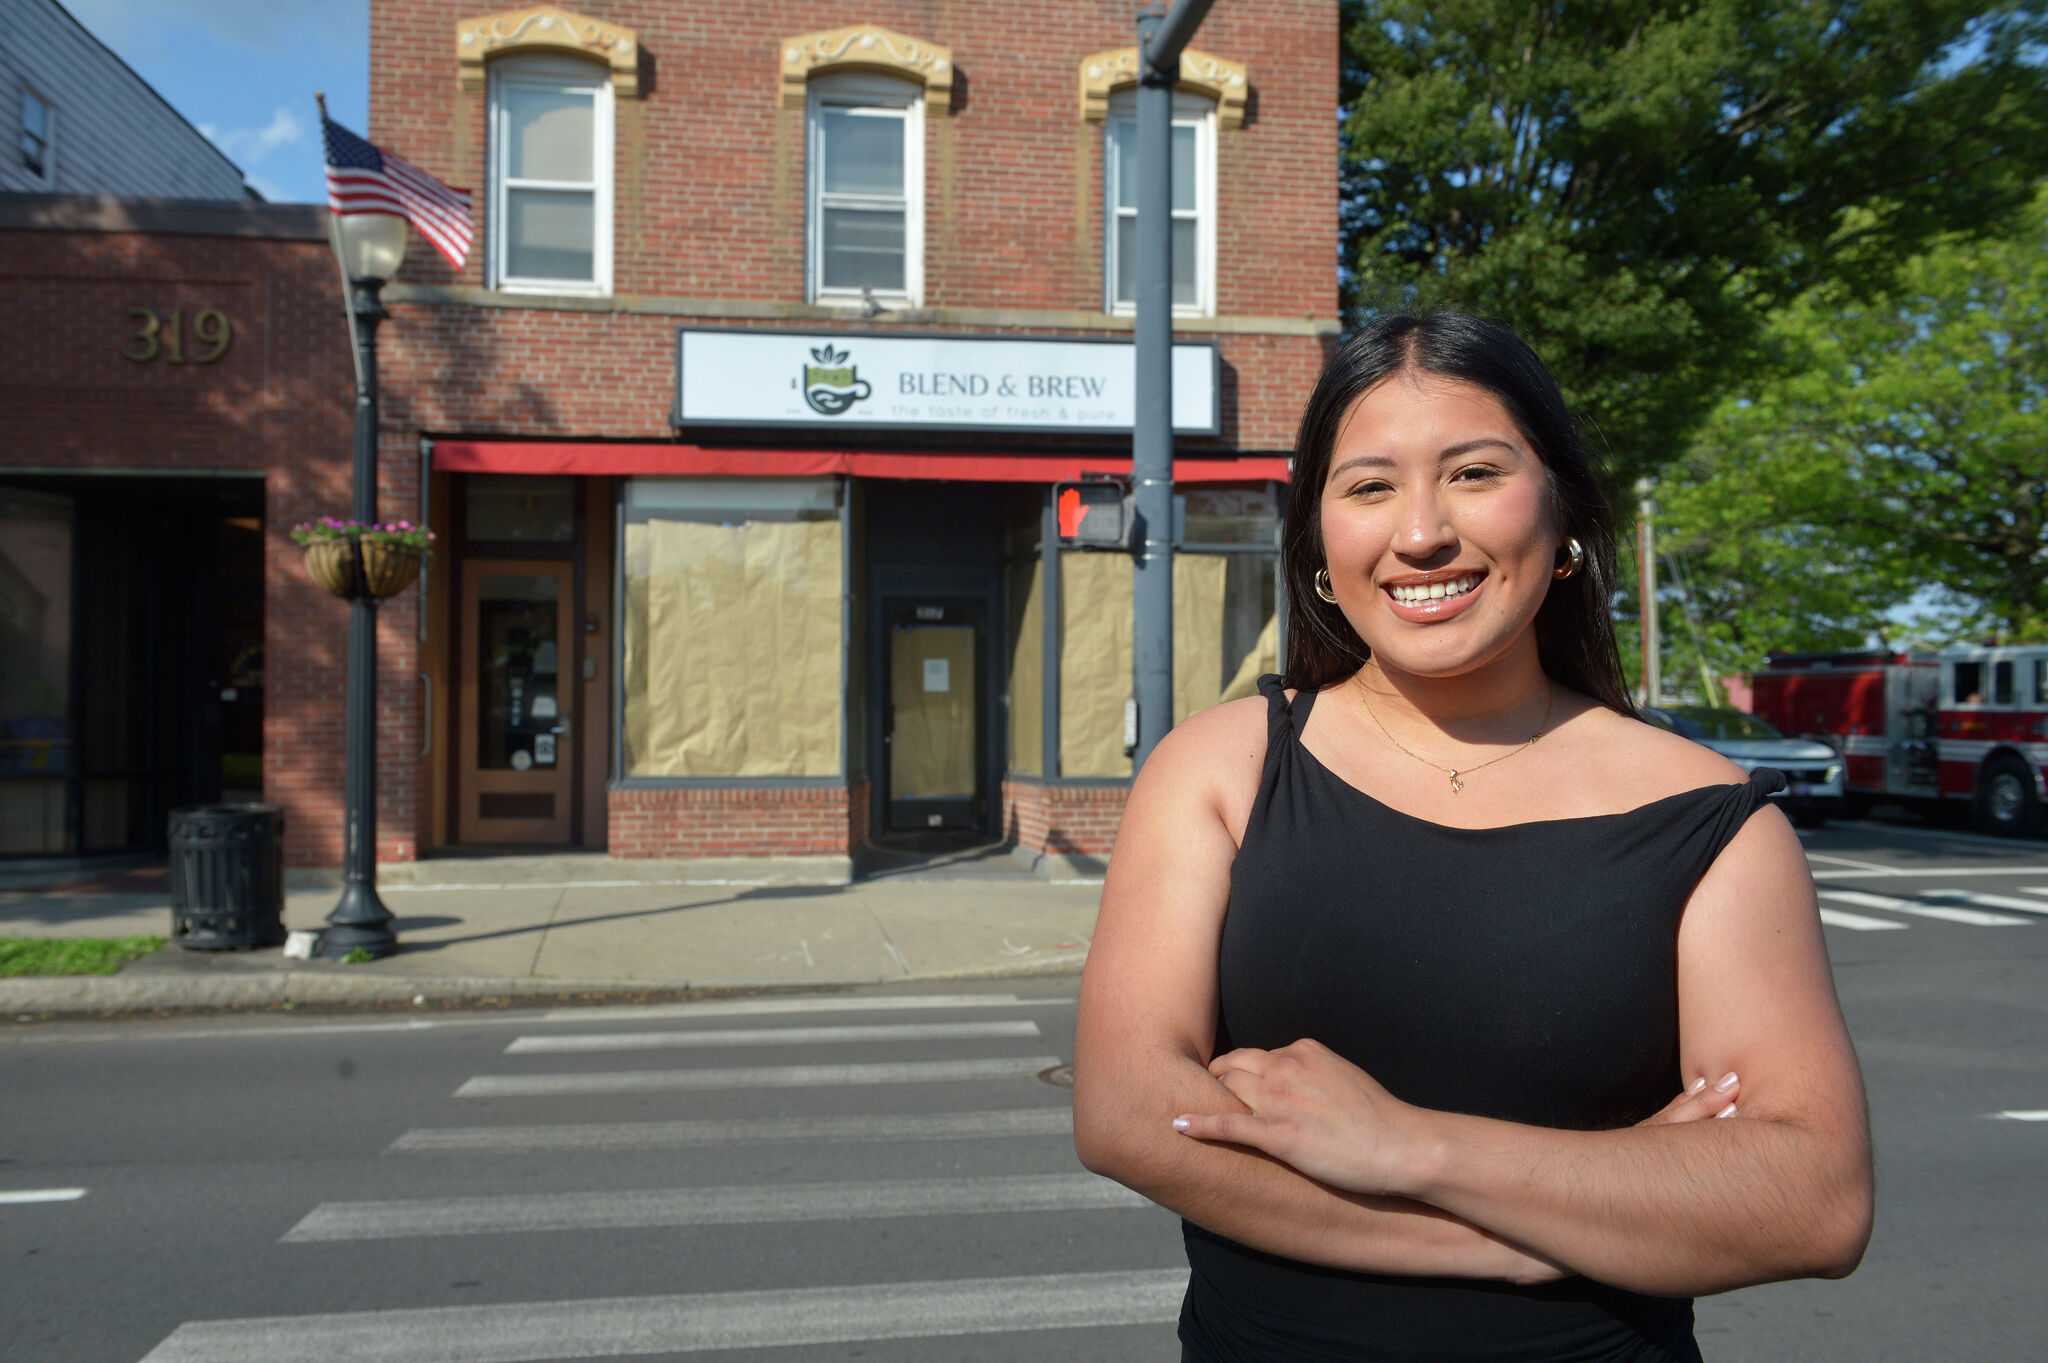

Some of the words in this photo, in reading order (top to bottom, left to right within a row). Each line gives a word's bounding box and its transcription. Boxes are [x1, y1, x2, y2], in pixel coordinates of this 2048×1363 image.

[122, 307, 233, 364] 319
[899, 372, 988, 397] BLEND
[996, 375, 1018, 398] &
[1029, 375, 1105, 399] BREW
[891, 405, 920, 417] the
[928, 406, 971, 419] taste
[981, 406, 998, 419] of
[1006, 407, 1050, 420] fresh
[1058, 409, 1069, 421] &
[1077, 410, 1116, 423] pure
